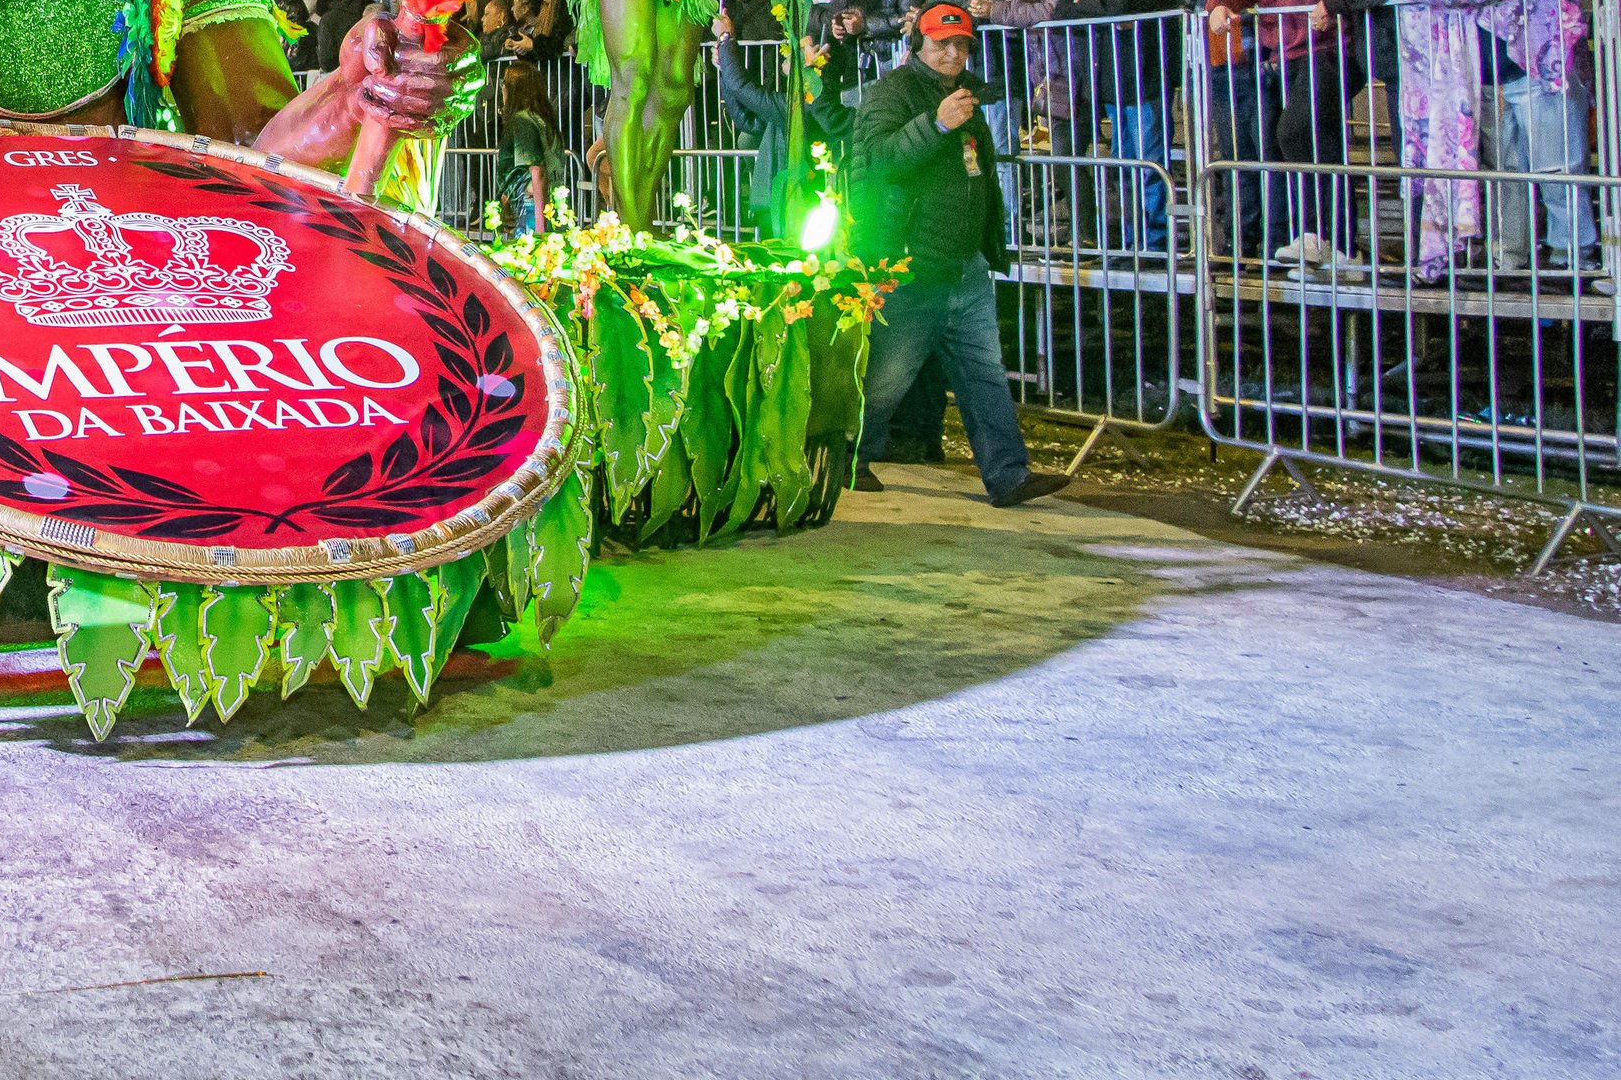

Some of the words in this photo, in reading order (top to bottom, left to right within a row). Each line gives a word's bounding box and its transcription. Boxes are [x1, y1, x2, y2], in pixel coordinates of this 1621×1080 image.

[3, 150, 99, 167] GRES
[11, 406, 126, 441] DA
[125, 395, 410, 436] BAIXADA
